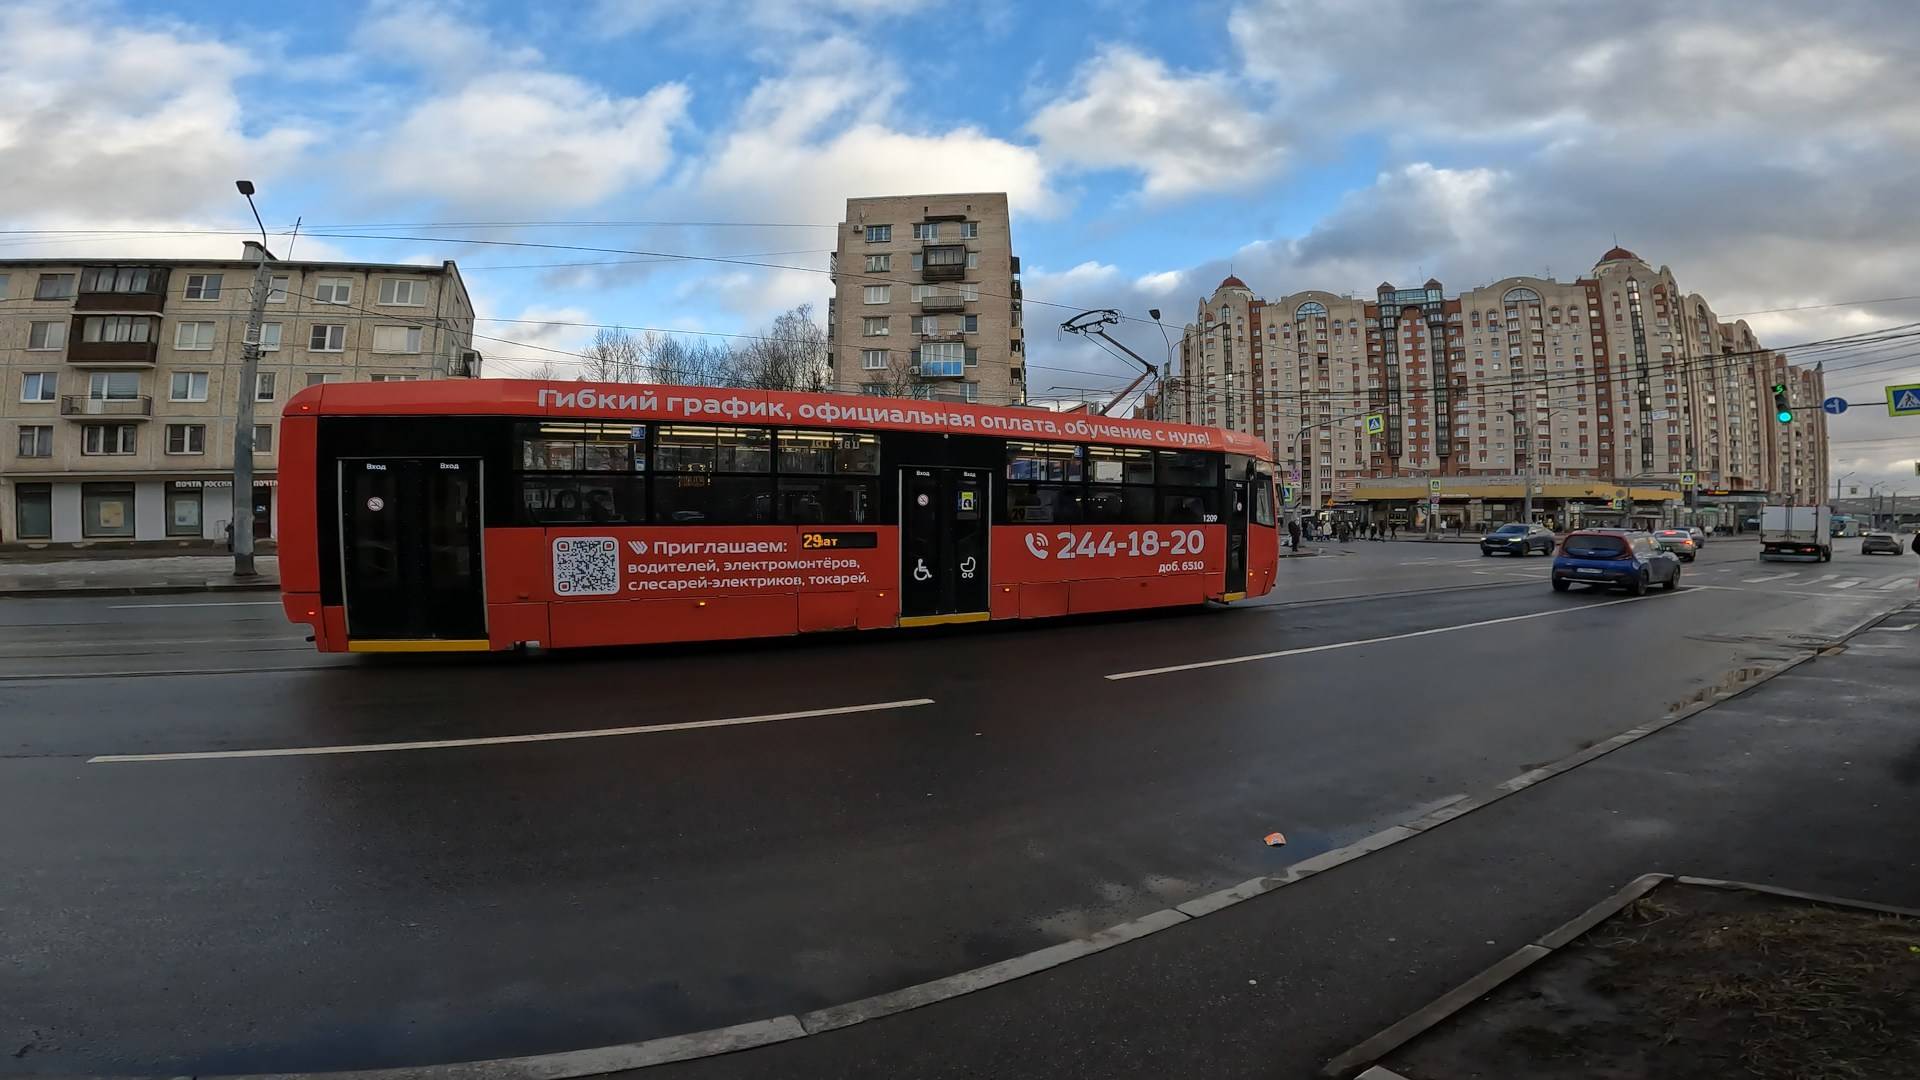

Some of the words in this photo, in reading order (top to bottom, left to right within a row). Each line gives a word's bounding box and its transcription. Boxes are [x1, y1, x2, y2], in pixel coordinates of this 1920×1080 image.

[538, 389, 657, 411] Гибкий
[667, 396, 791, 420] график,
[798, 402, 976, 425] официальная
[980, 415, 1062, 436] оплата,
[1064, 420, 1151, 441] обучение
[1155, 429, 1165, 441] с
[1167, 431, 1210, 446] нуля!
[440, 462, 459, 470] Вход
[1203, 514, 1218, 522] 1209
[653, 541, 788, 557] Приглашаем:
[1056, 530, 1205, 559] 244-18-20
[628, 559, 720, 573] водителей,
[723, 557, 860, 571] электромонтёров,
[1158, 562, 1180, 573] доб.
[1182, 561, 1204, 571] 6510
[628, 575, 806, 591] слесарей-электриков,
[808, 572, 870, 585] токарей.
